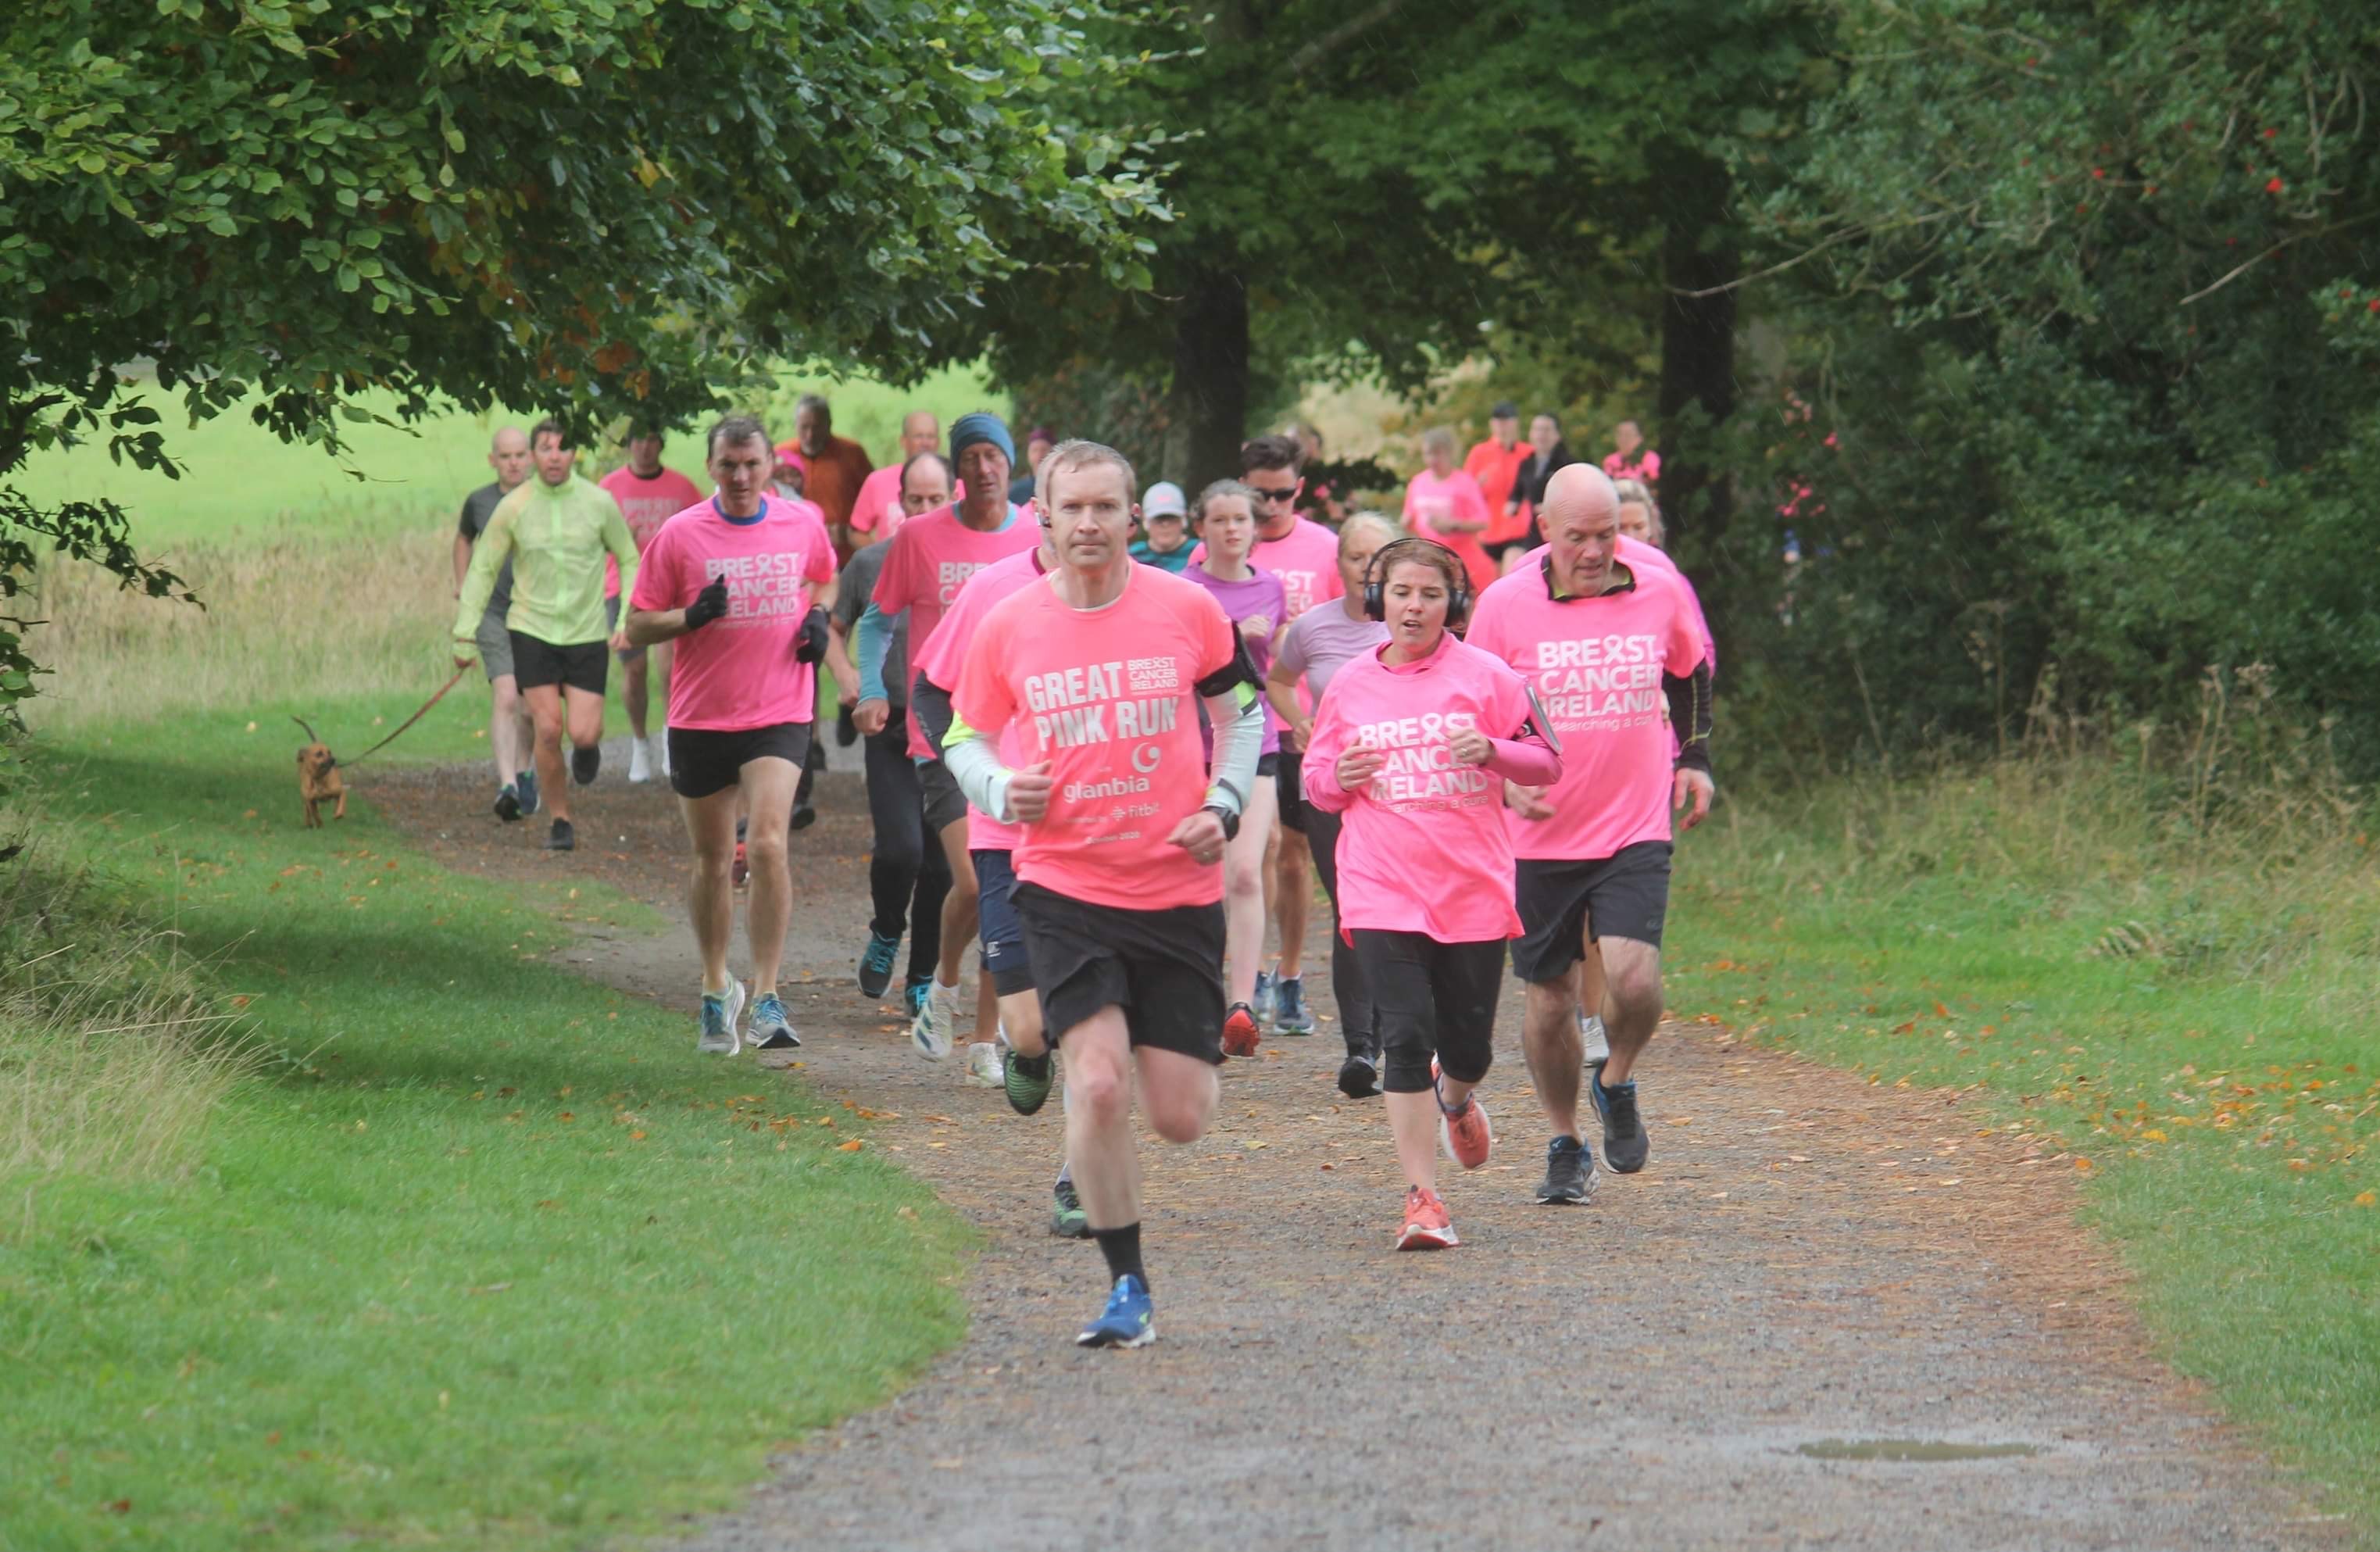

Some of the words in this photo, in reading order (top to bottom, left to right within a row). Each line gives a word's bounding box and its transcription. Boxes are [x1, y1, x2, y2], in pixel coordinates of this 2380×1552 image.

[727, 576, 801, 599] ANCER
[1024, 661, 1124, 713] GREAT
[1129, 668, 1178, 681] CANCER
[1130, 678, 1179, 690] IRELAND
[1538, 663, 1658, 696] CANCER
[1538, 689, 1655, 717] IRELAND
[1035, 704, 1110, 753] PINK
[1116, 696, 1178, 739] RUN
[1063, 775, 1151, 803] glanbia
